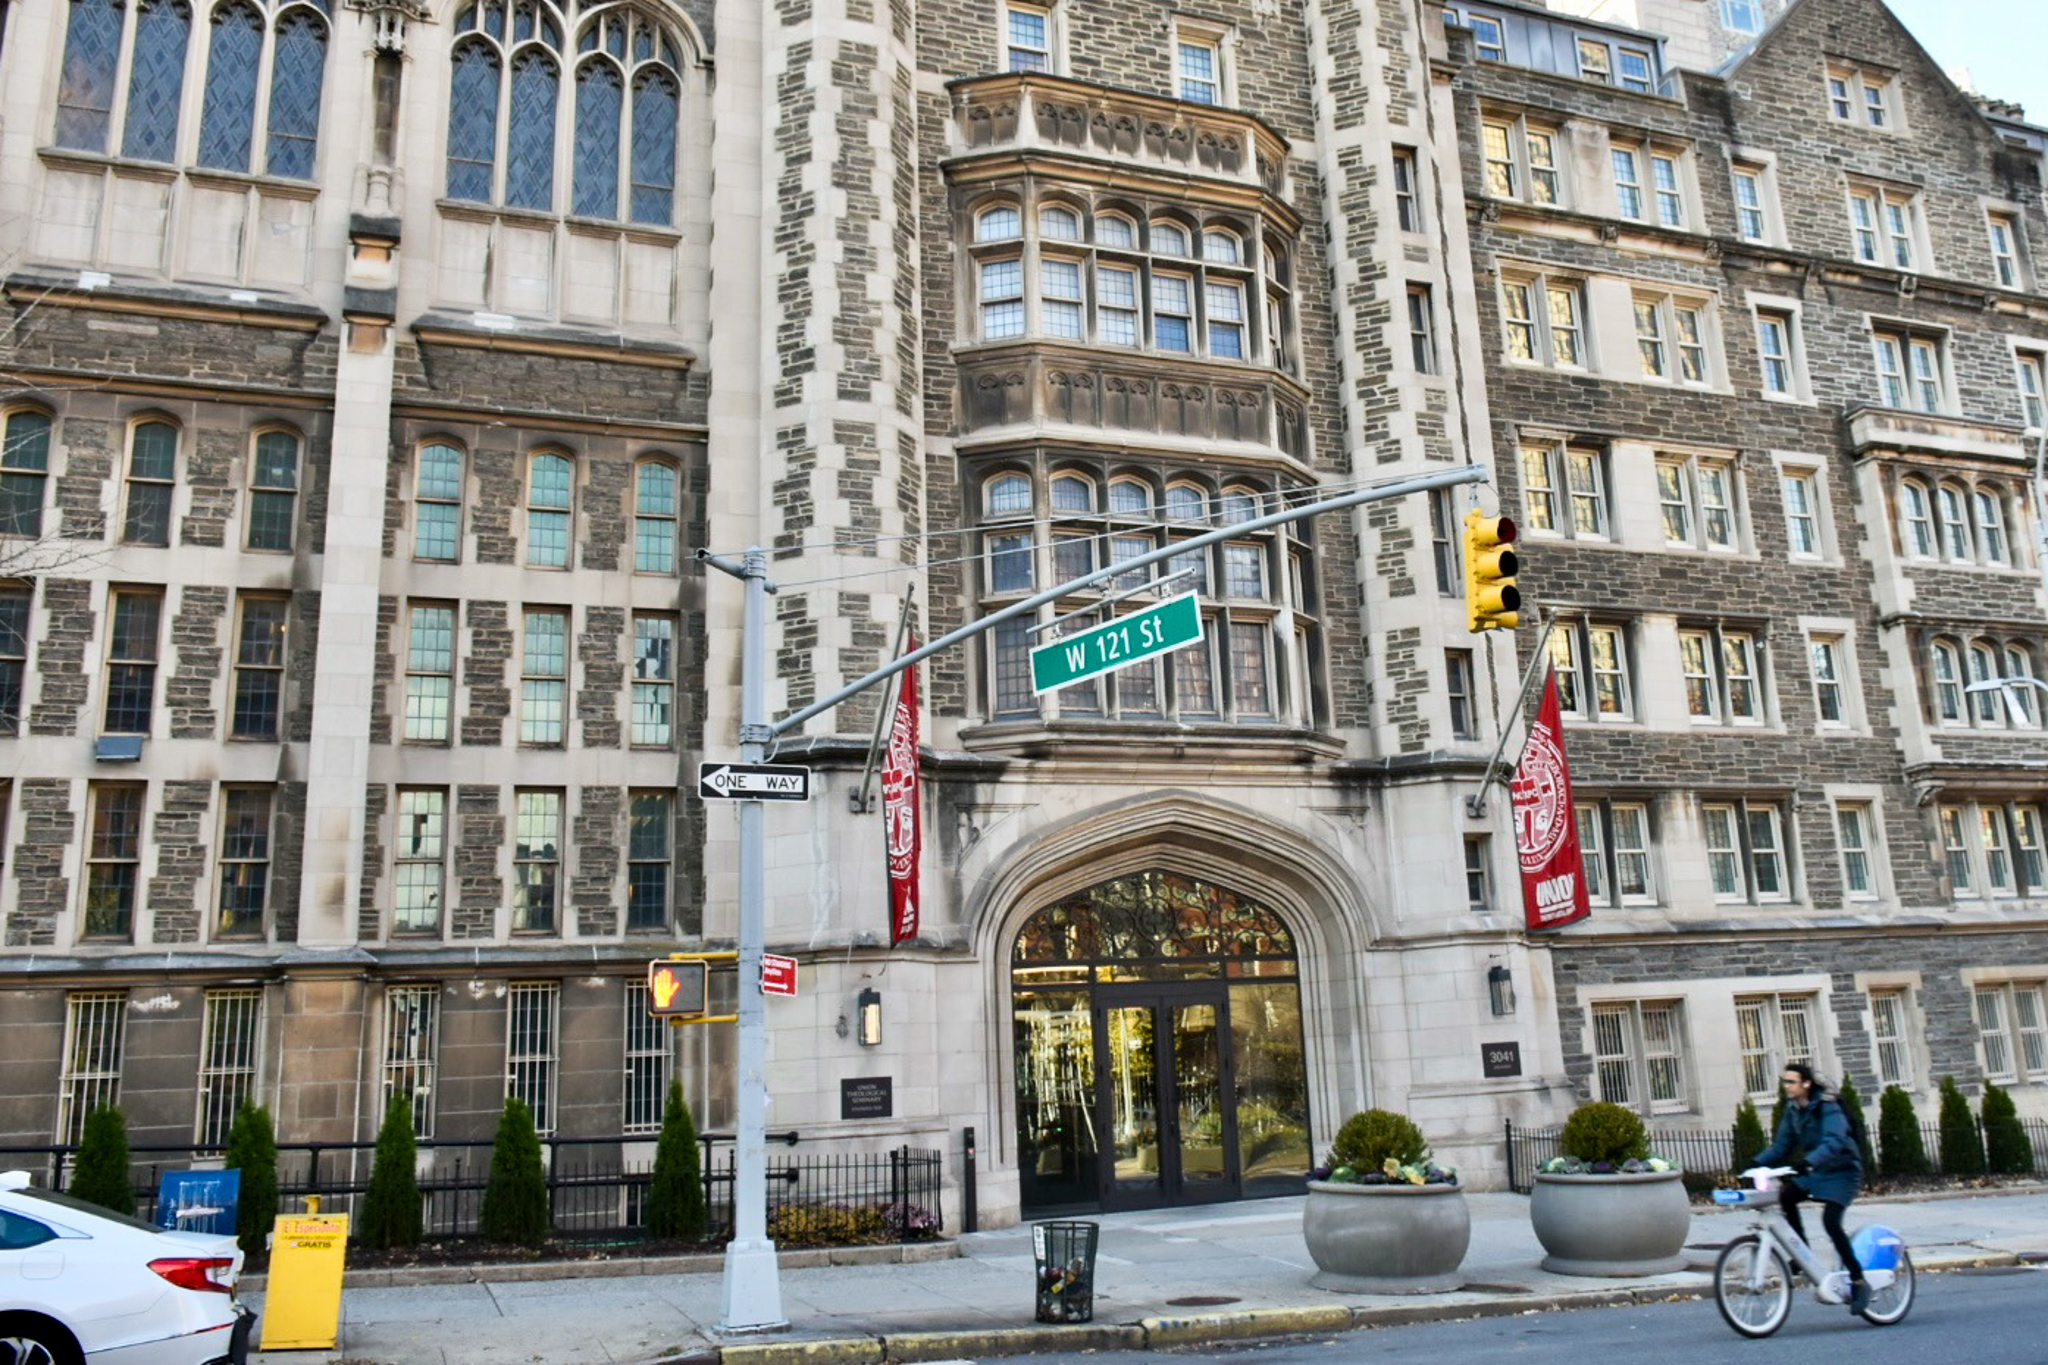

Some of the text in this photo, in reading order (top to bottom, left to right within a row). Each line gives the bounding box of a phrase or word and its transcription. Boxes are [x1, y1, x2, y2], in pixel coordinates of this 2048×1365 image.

[1065, 615, 1164, 673] W 121 St
[715, 774, 799, 790] ONE WAY
[1489, 1050, 1514, 1063] 3041
